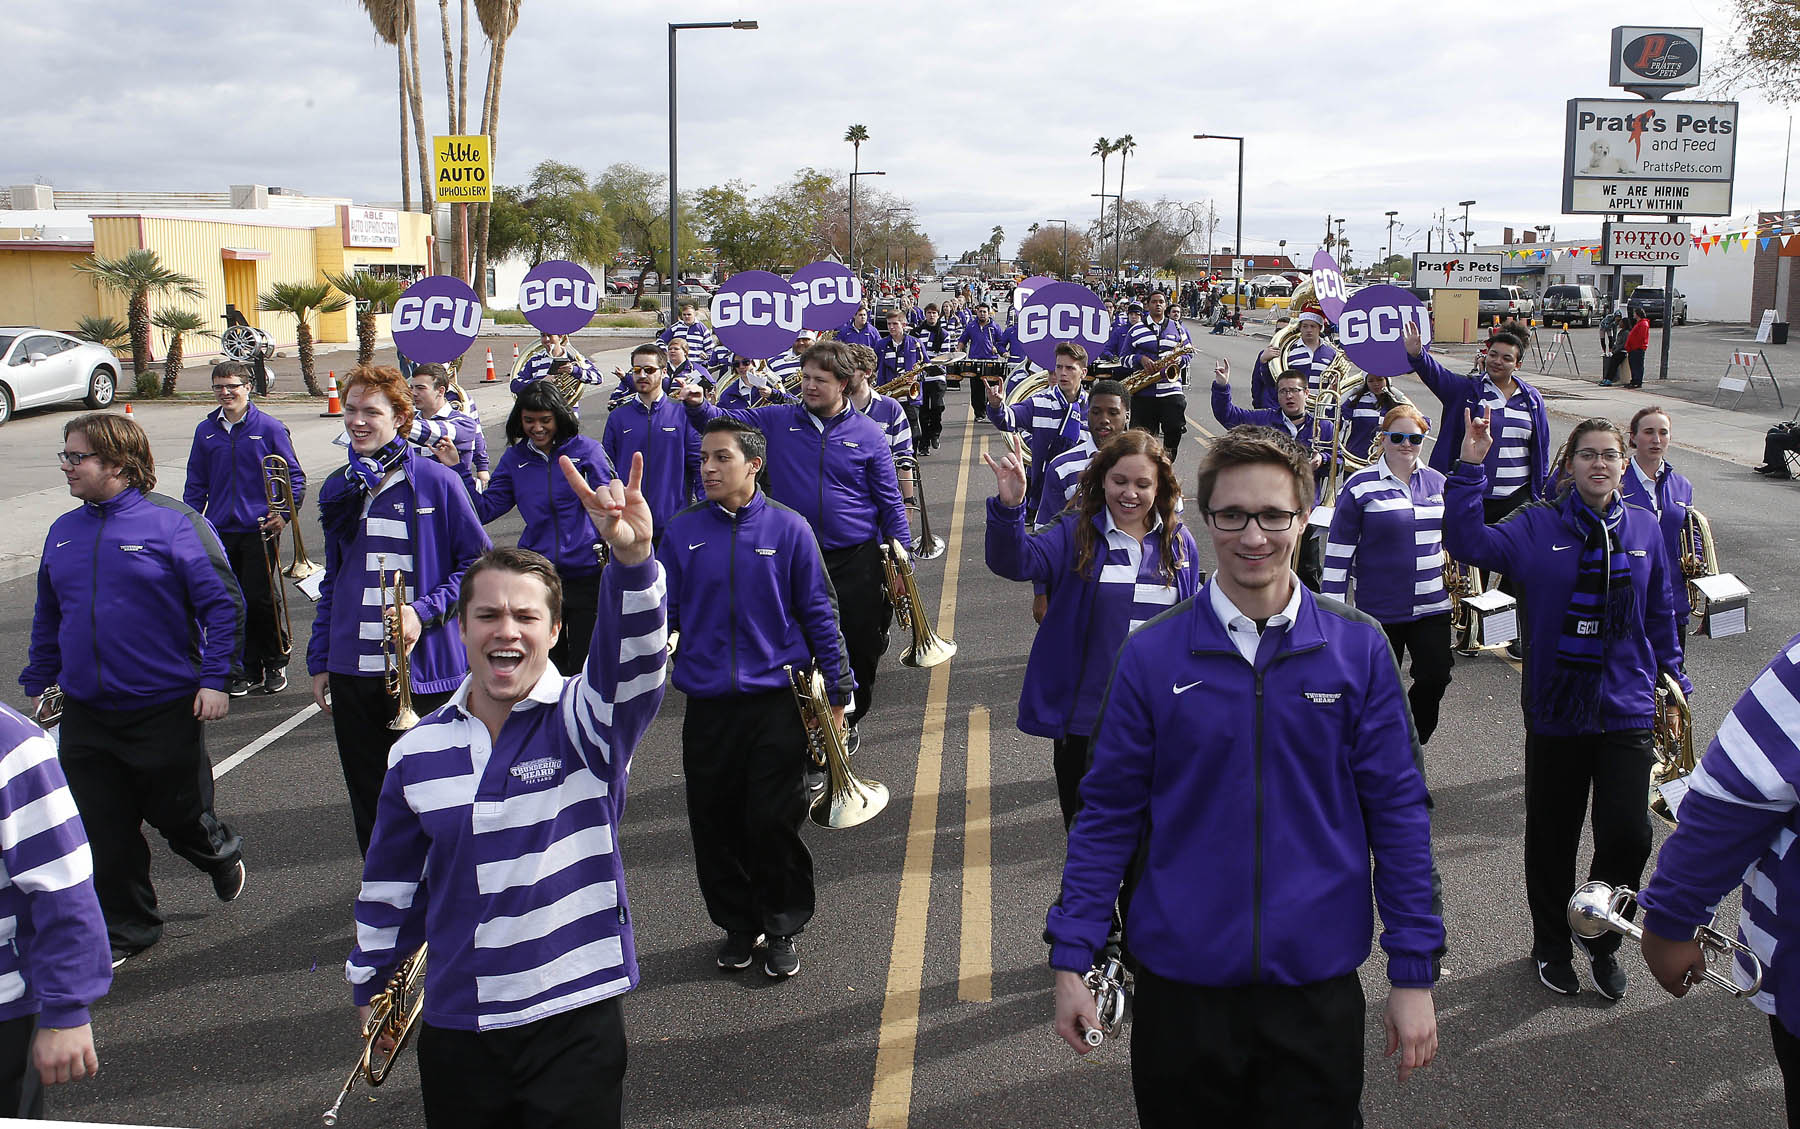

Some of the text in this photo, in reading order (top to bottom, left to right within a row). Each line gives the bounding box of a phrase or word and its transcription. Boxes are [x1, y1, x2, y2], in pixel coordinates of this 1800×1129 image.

[1635, 36, 1666, 68] P
[1676, 114, 1733, 135] Pets
[440, 142, 481, 162] Able
[1651, 138, 1716, 152] and Feed
[1643, 161, 1722, 174] PrattsPets.com
[439, 168, 486, 182] AUTO
[1602, 185, 1689, 197] WE ARE HIRING
[1608, 199, 1683, 210] APPLY WITHIN
[363, 211, 384, 220] ABLE
[1613, 231, 1686, 246] TATTOO
[1615, 251, 1680, 262] PIERCING
[1469, 262, 1500, 272] Pets
[1312, 268, 1348, 304] GCU
[1475, 275, 1493, 283] Feed
[519, 278, 599, 313] GCU
[391, 296, 483, 338] GCU
[711, 291, 803, 333] GCU
[1018, 303, 1111, 344] GCU
[1338, 305, 1432, 346] GCU
[1577, 621, 1600, 635] GCU
[510, 760, 562, 777] THUNDERING
[522, 768, 556, 781] HEARD
